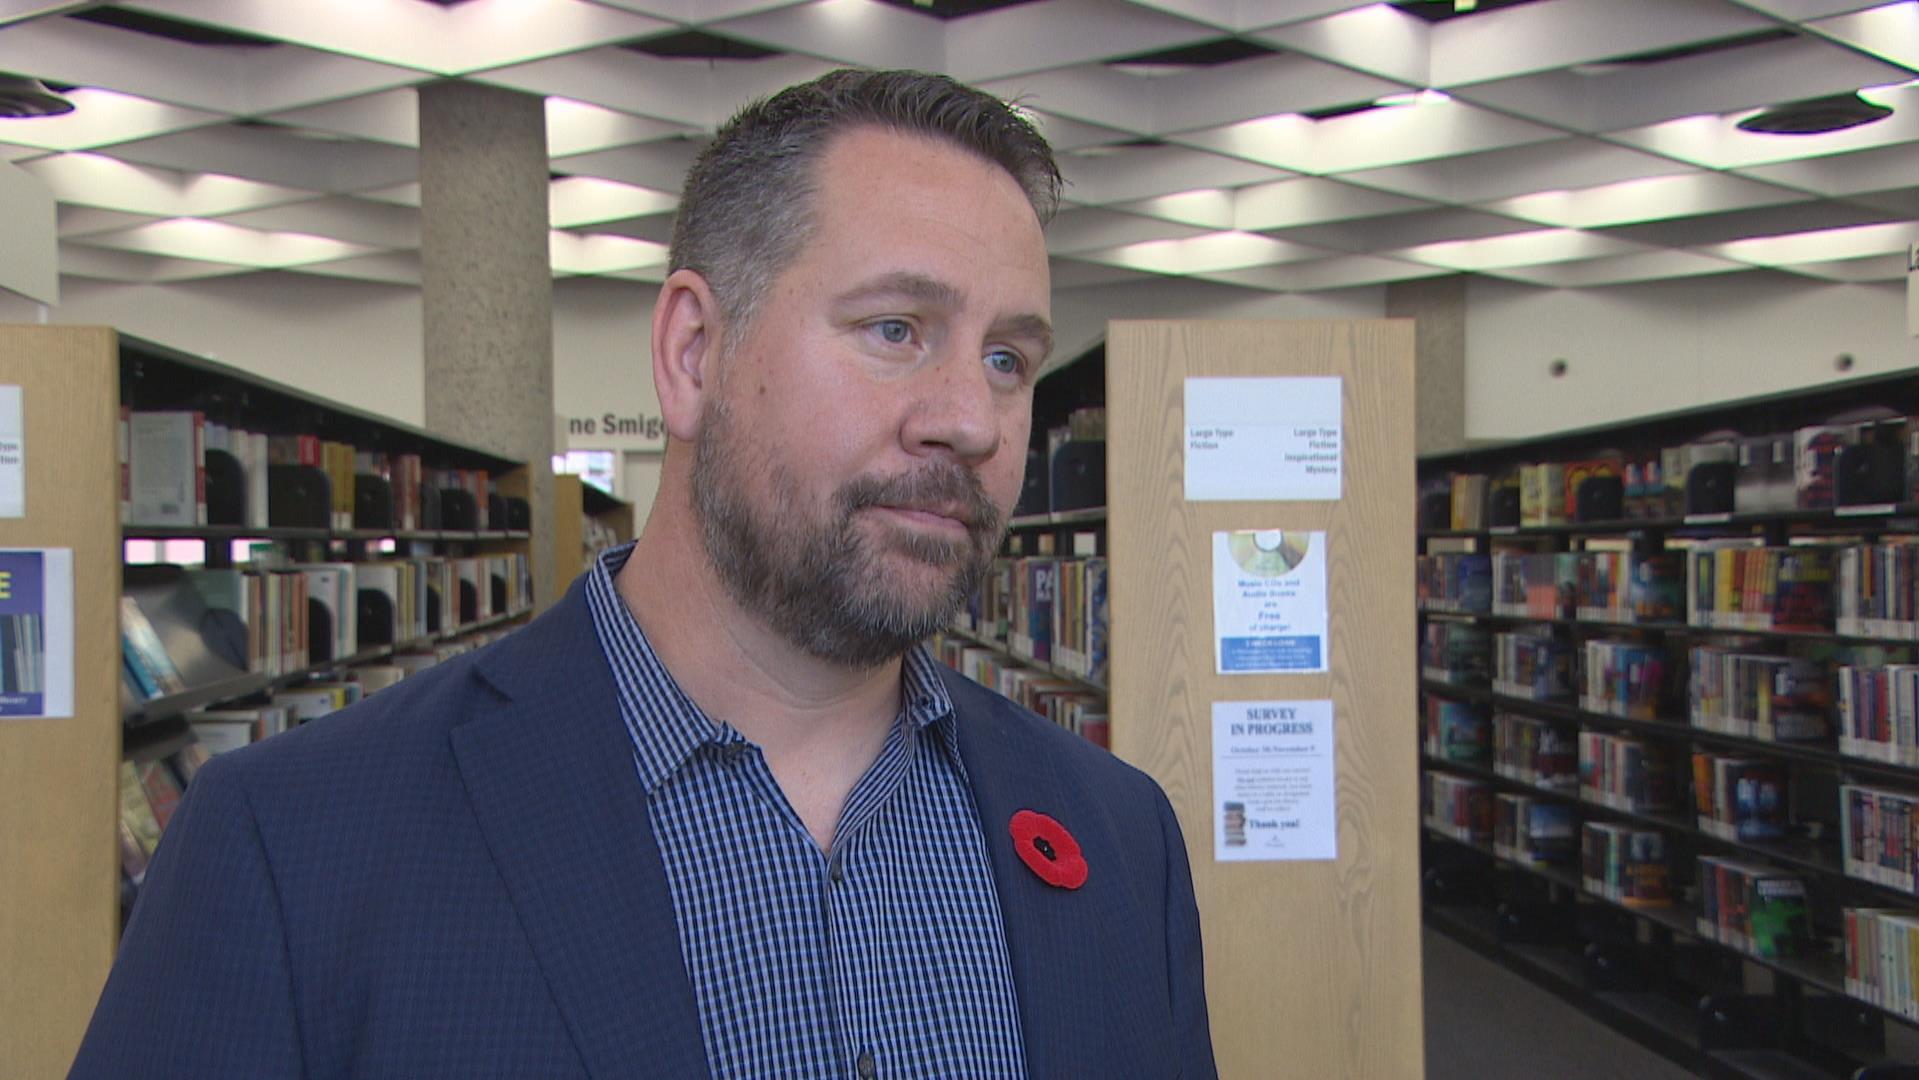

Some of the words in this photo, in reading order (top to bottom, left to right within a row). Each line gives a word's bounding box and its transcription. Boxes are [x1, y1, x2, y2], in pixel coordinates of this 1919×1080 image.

[570, 418, 596, 434] ne
[1190, 428, 1213, 439] Large
[1215, 427, 1234, 439] Type
[1293, 428, 1316, 438] Large
[1319, 427, 1337, 439] Type
[1190, 440, 1219, 449] Fiction
[1309, 440, 1337, 449] Fiction
[1284, 452, 1337, 463] Inspirational
[1305, 465, 1337, 475] Mystery
[1238, 580, 1262, 588] Music
[1284, 579, 1300, 587] and
[1242, 590, 1267, 598] Audio
[1258, 611, 1281, 621] Free
[1247, 707, 1298, 720] SURVEY
[1231, 722, 1245, 736] IN
[1247, 721, 1313, 736] PROGRESS
[1249, 819, 1278, 830] Thank
[1280, 818, 1300, 832] you!
